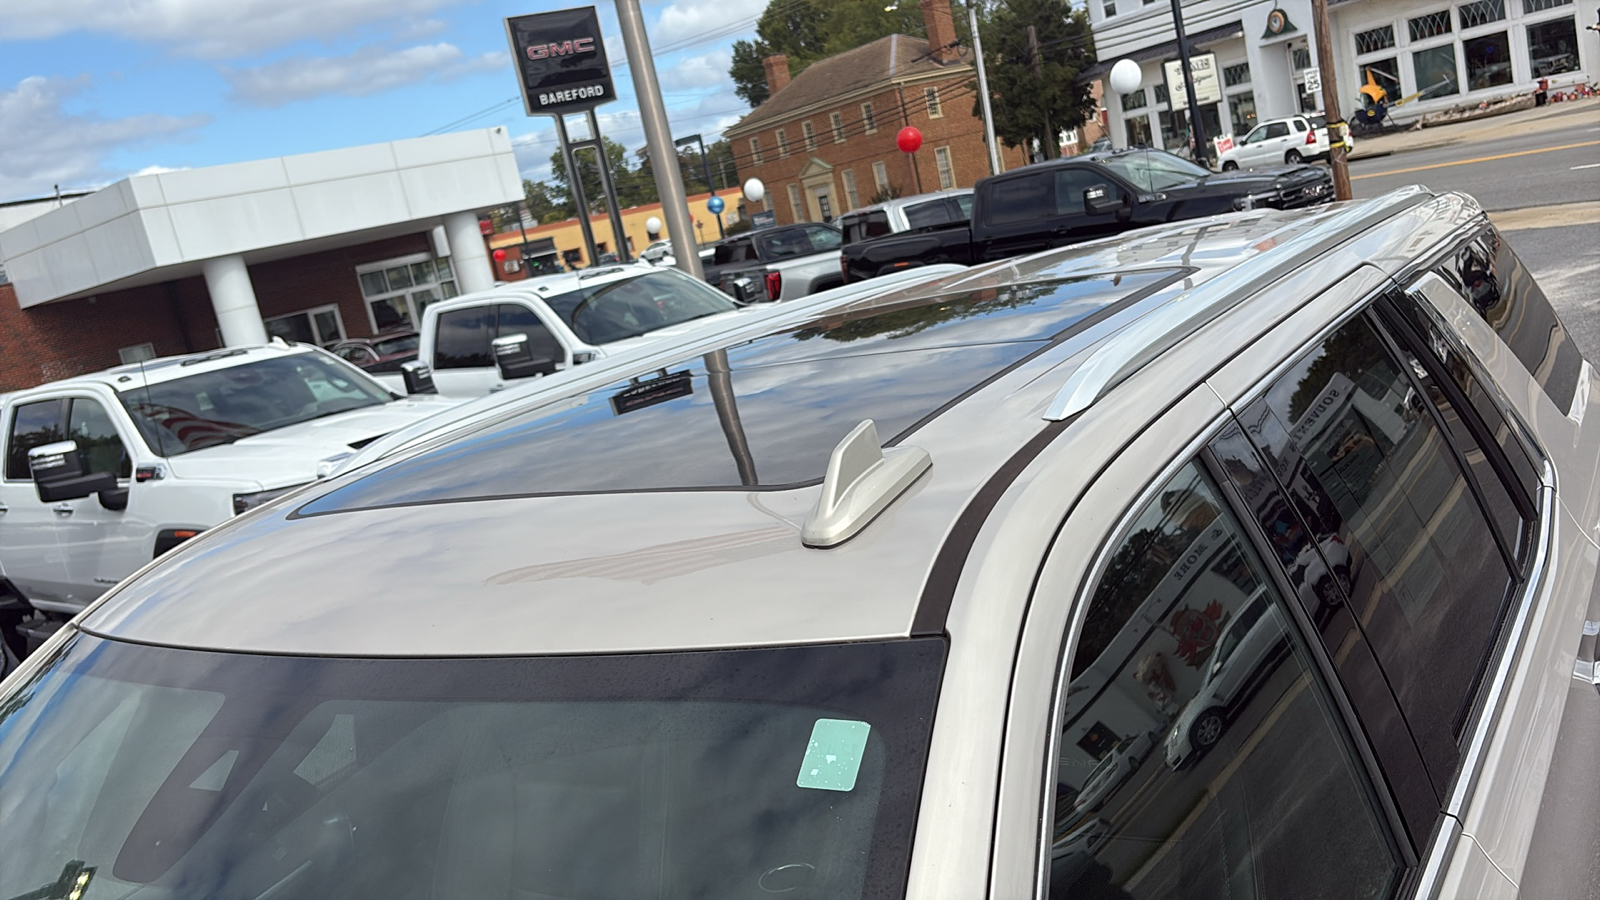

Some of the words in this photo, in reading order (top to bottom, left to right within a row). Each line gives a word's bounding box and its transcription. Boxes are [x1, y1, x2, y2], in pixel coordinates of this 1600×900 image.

[527, 37, 595, 60] GMC
[539, 85, 604, 105] BAREFORD
[1307, 79, 1320, 91] 25
